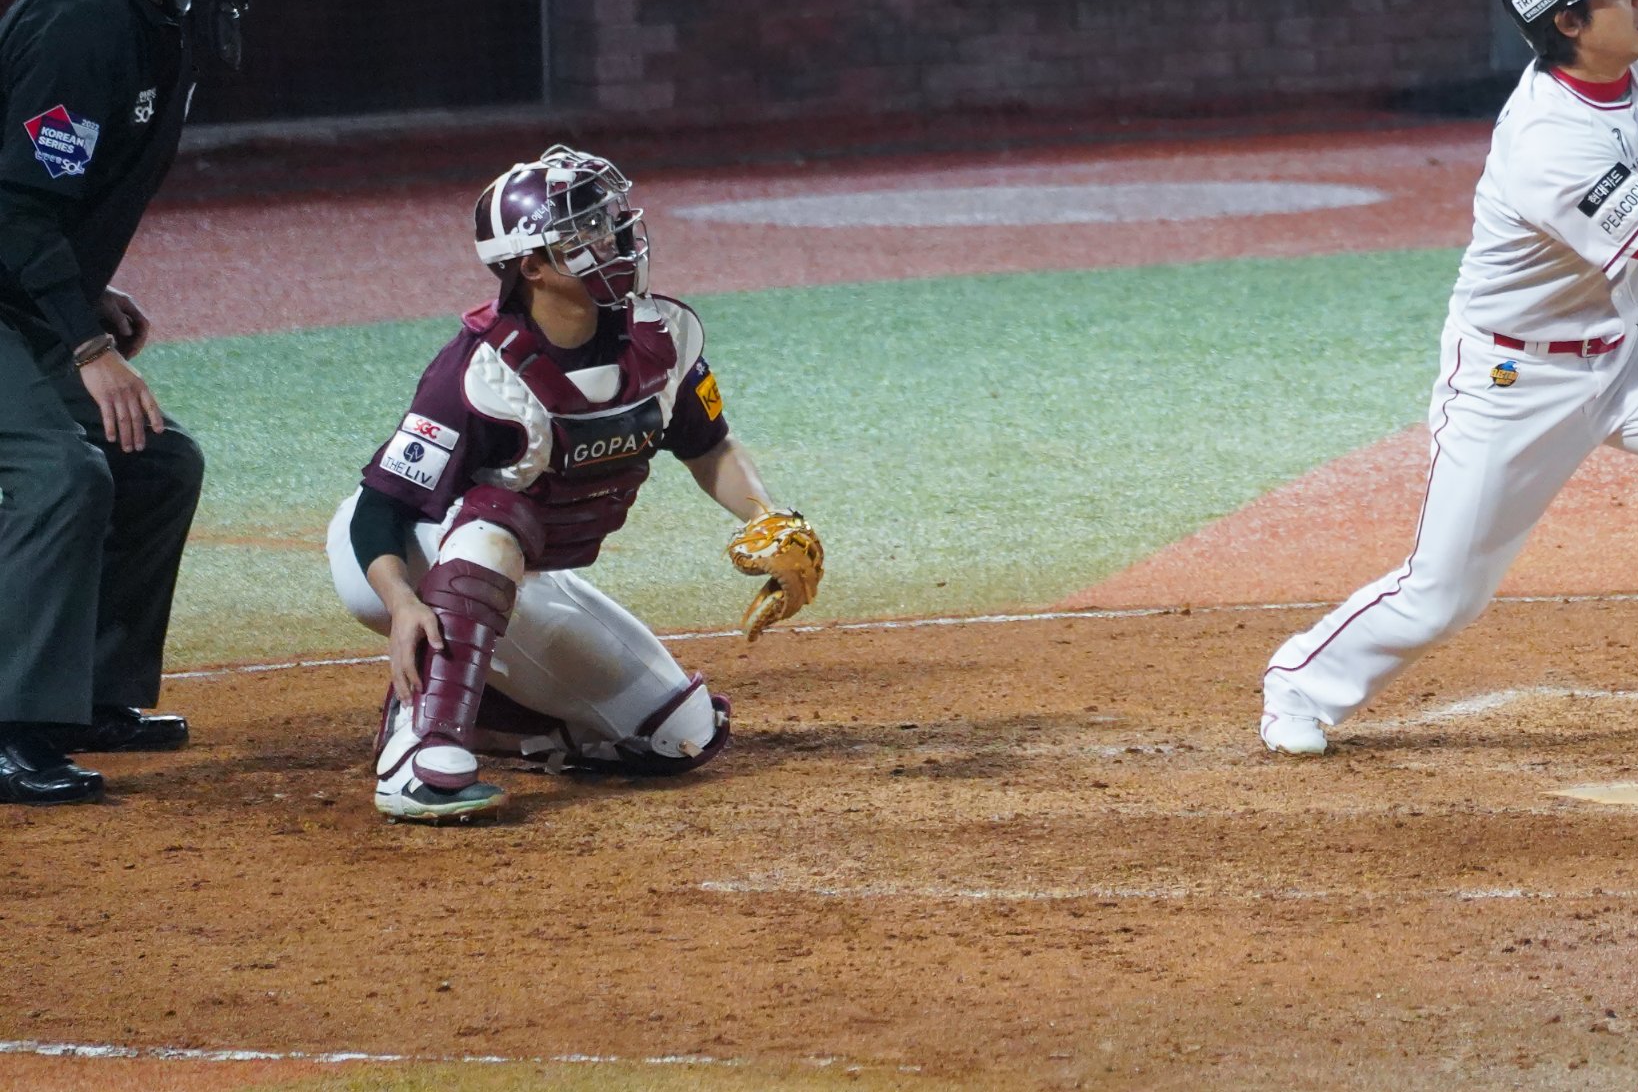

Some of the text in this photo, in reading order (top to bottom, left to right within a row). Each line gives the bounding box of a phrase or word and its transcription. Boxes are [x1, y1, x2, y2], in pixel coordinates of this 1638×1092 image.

[38, 136, 75, 154] SERIES
[40, 126, 85, 147] KOREAN
[1587, 170, 1624, 205] 현대카드
[414, 419, 441, 439] SGC
[573, 429, 656, 462] GOPAX
[387, 456, 433, 485] THE LIV
